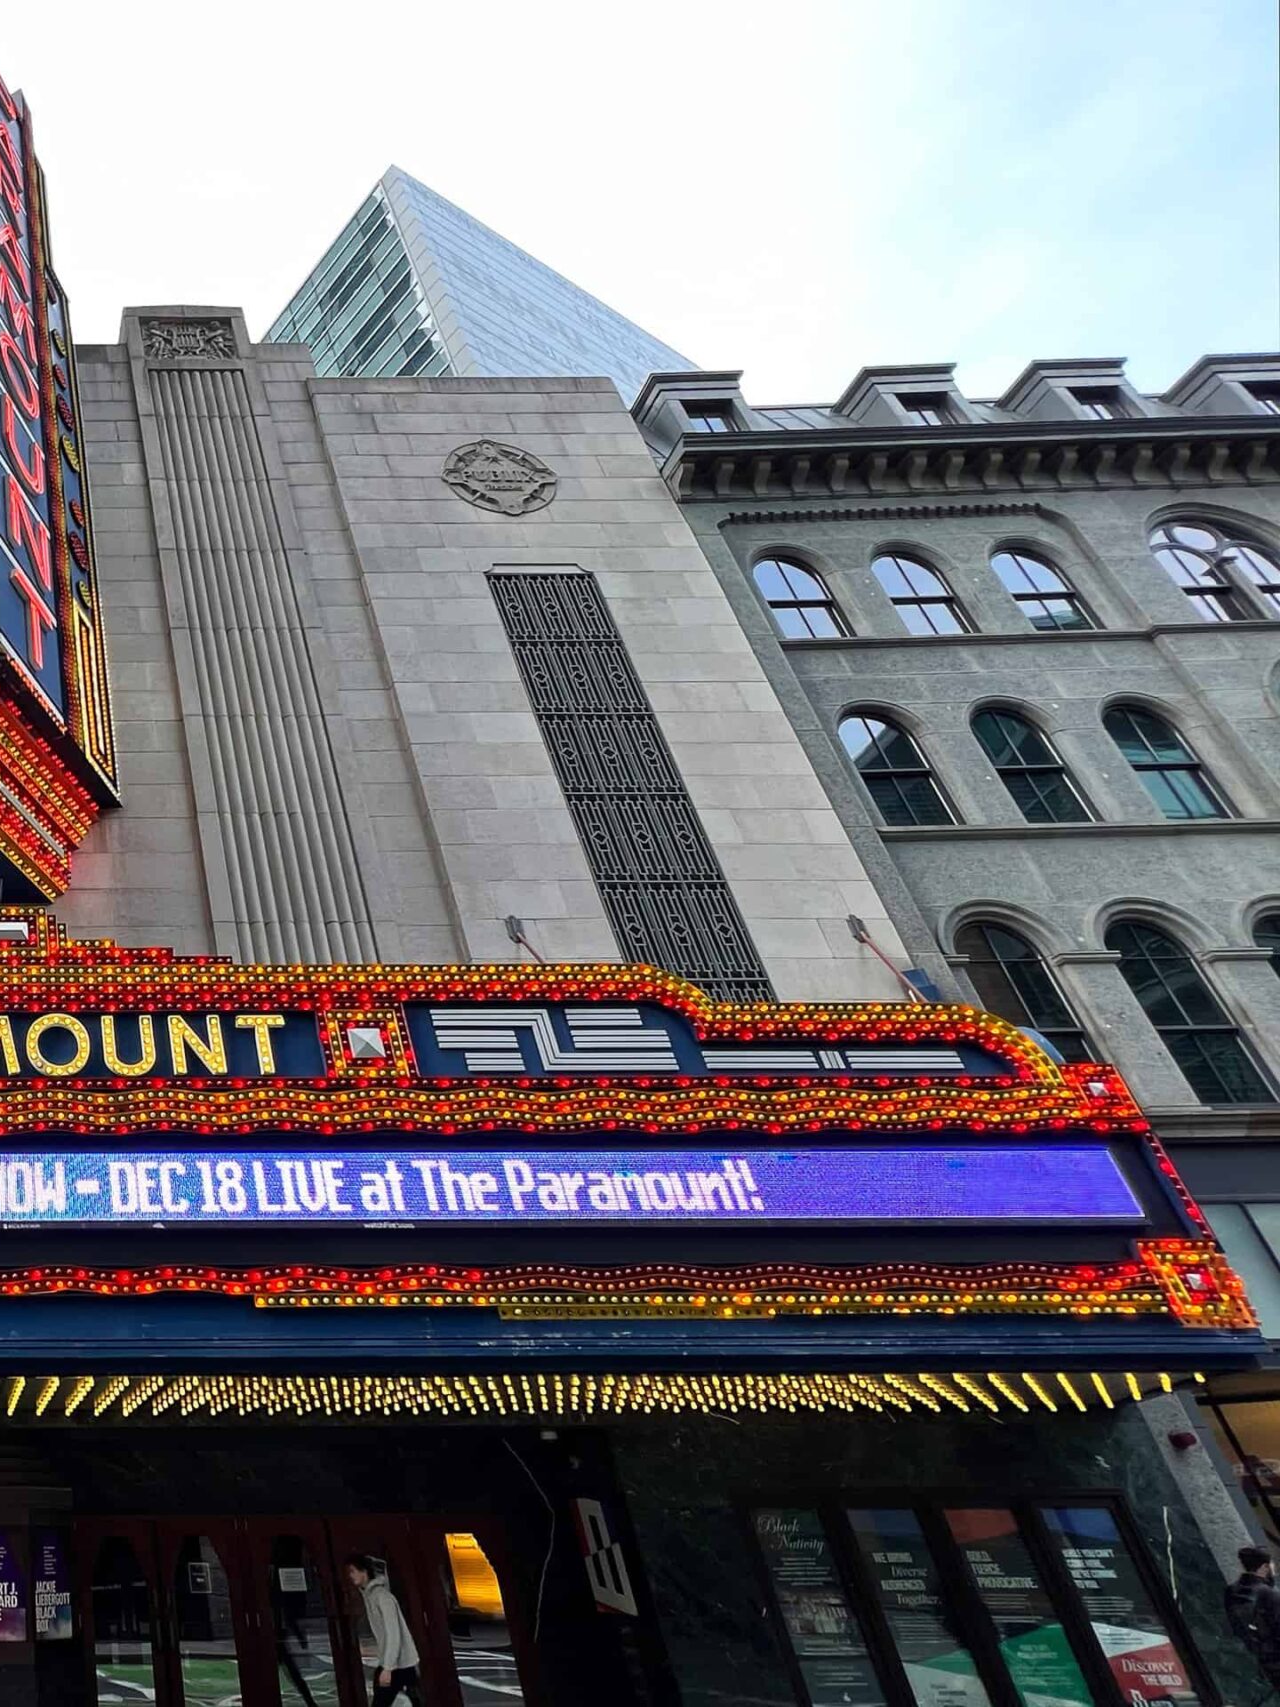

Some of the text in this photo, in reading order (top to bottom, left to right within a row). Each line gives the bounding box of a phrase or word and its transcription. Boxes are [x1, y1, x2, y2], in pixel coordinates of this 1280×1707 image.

[109, 1161, 189, 1214] DEC
[197, 1160, 247, 1213] 18
[253, 1160, 352, 1213] LIVE
[359, 1161, 407, 1212] at
[411, 1160, 502, 1212] The
[503, 1160, 765, 1212] Paramount!
[758, 1514, 801, 1535] Black
[9, 1582, 19, 1595] J.
[36, 1581, 56, 1593] JACKIE
[35, 1606, 57, 1619] BLACK
[35, 1620, 50, 1633] BOX
